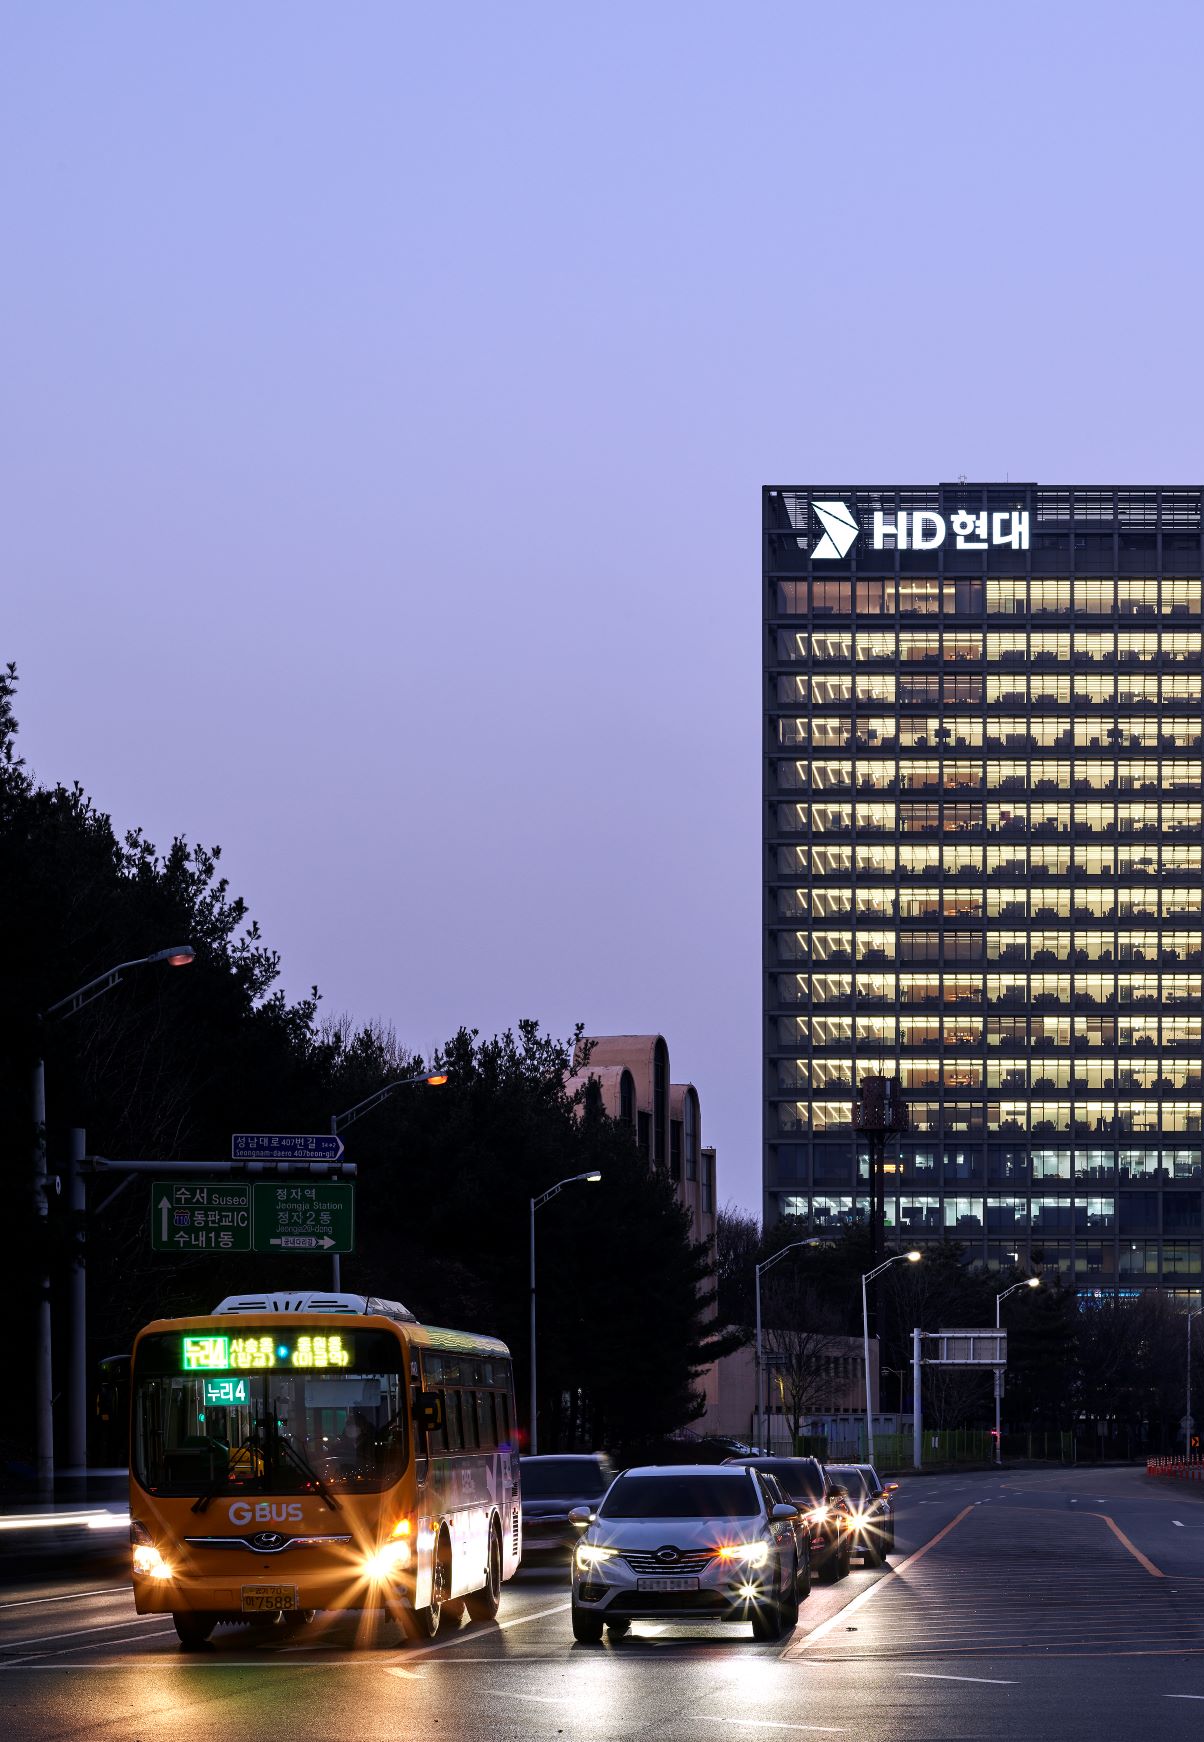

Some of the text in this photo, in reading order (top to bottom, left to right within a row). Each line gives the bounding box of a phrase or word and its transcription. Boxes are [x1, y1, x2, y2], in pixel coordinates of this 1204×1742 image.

[175, 1187, 247, 1205] 수서 Suseo
[276, 1201, 343, 1210] Jeongja Station
[173, 1230, 235, 1248] 수내1동
[207, 1380, 245, 1402] 누리4
